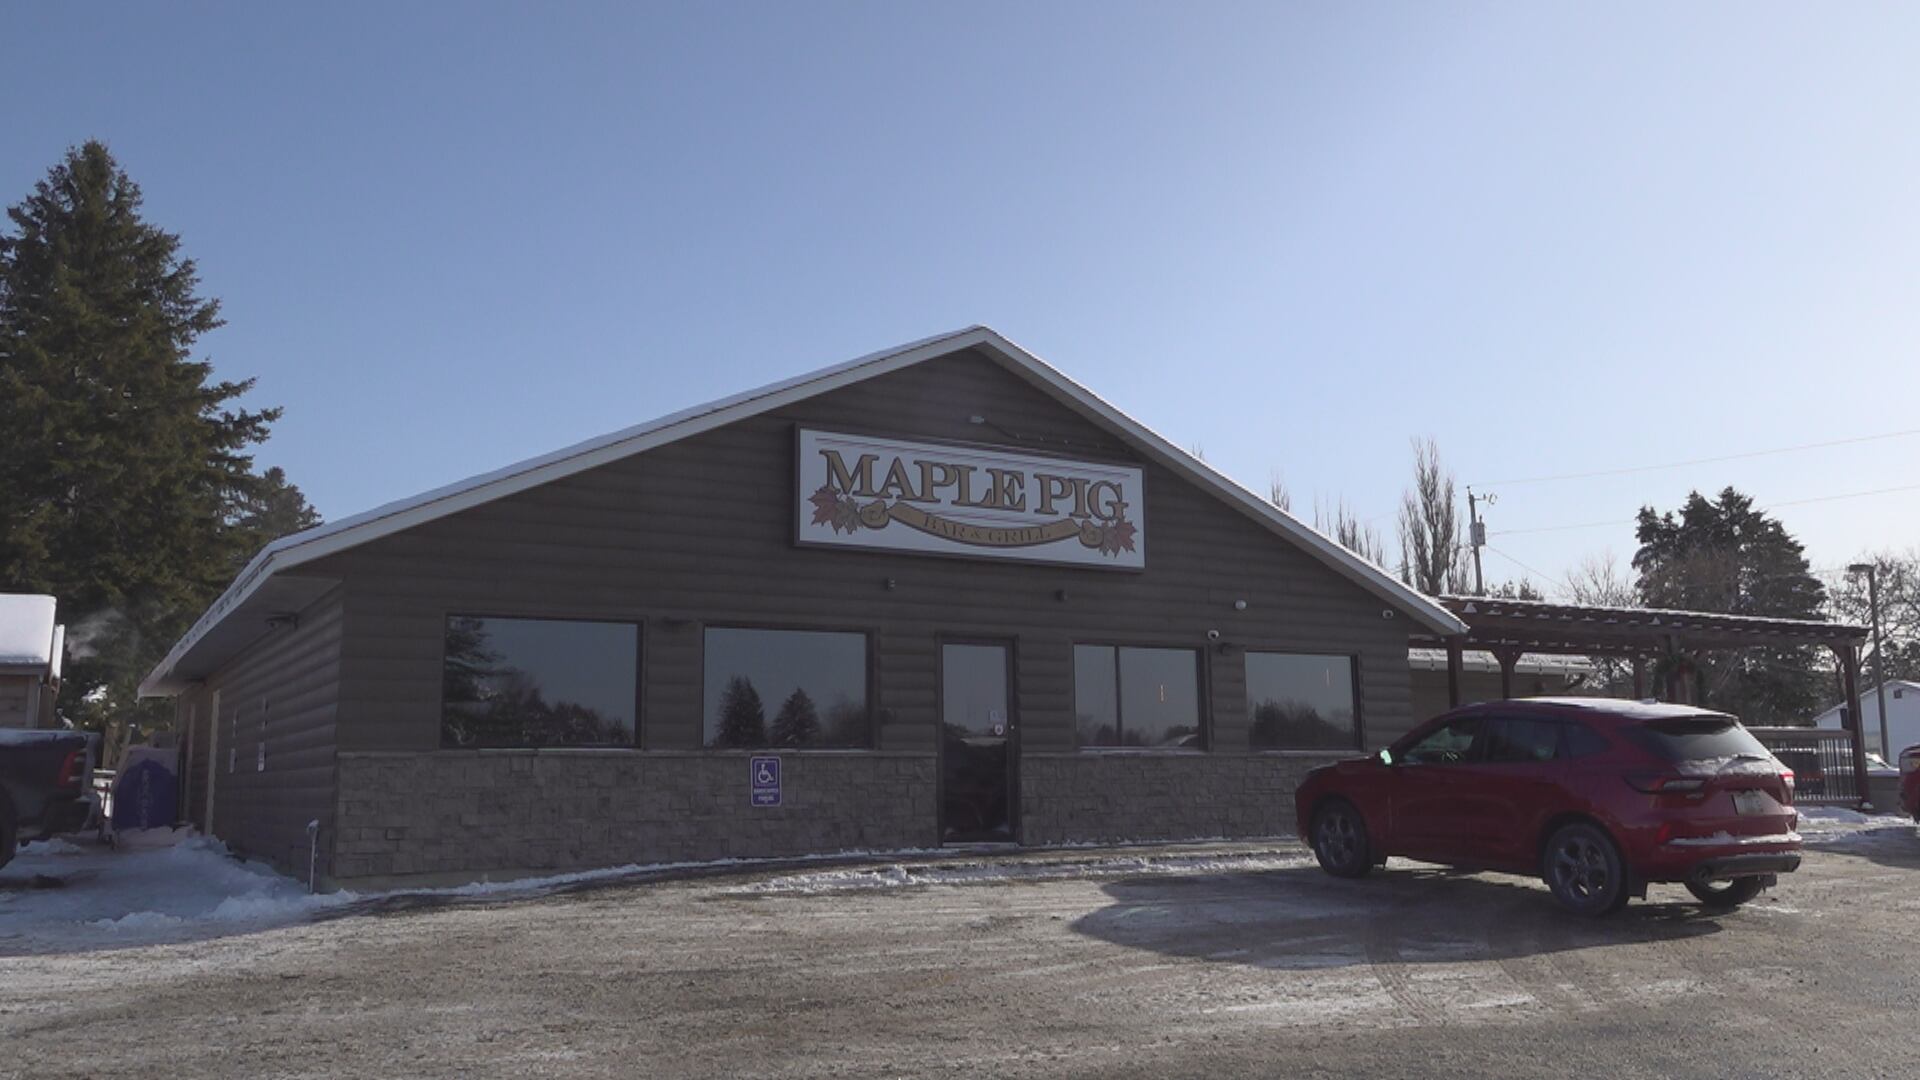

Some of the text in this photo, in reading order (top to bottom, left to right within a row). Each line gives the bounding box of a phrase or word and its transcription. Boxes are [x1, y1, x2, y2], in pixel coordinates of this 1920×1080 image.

[819, 449, 1129, 521] MAPLE PIG
[922, 513, 965, 538] BAR
[987, 527, 1051, 543] GRILL
